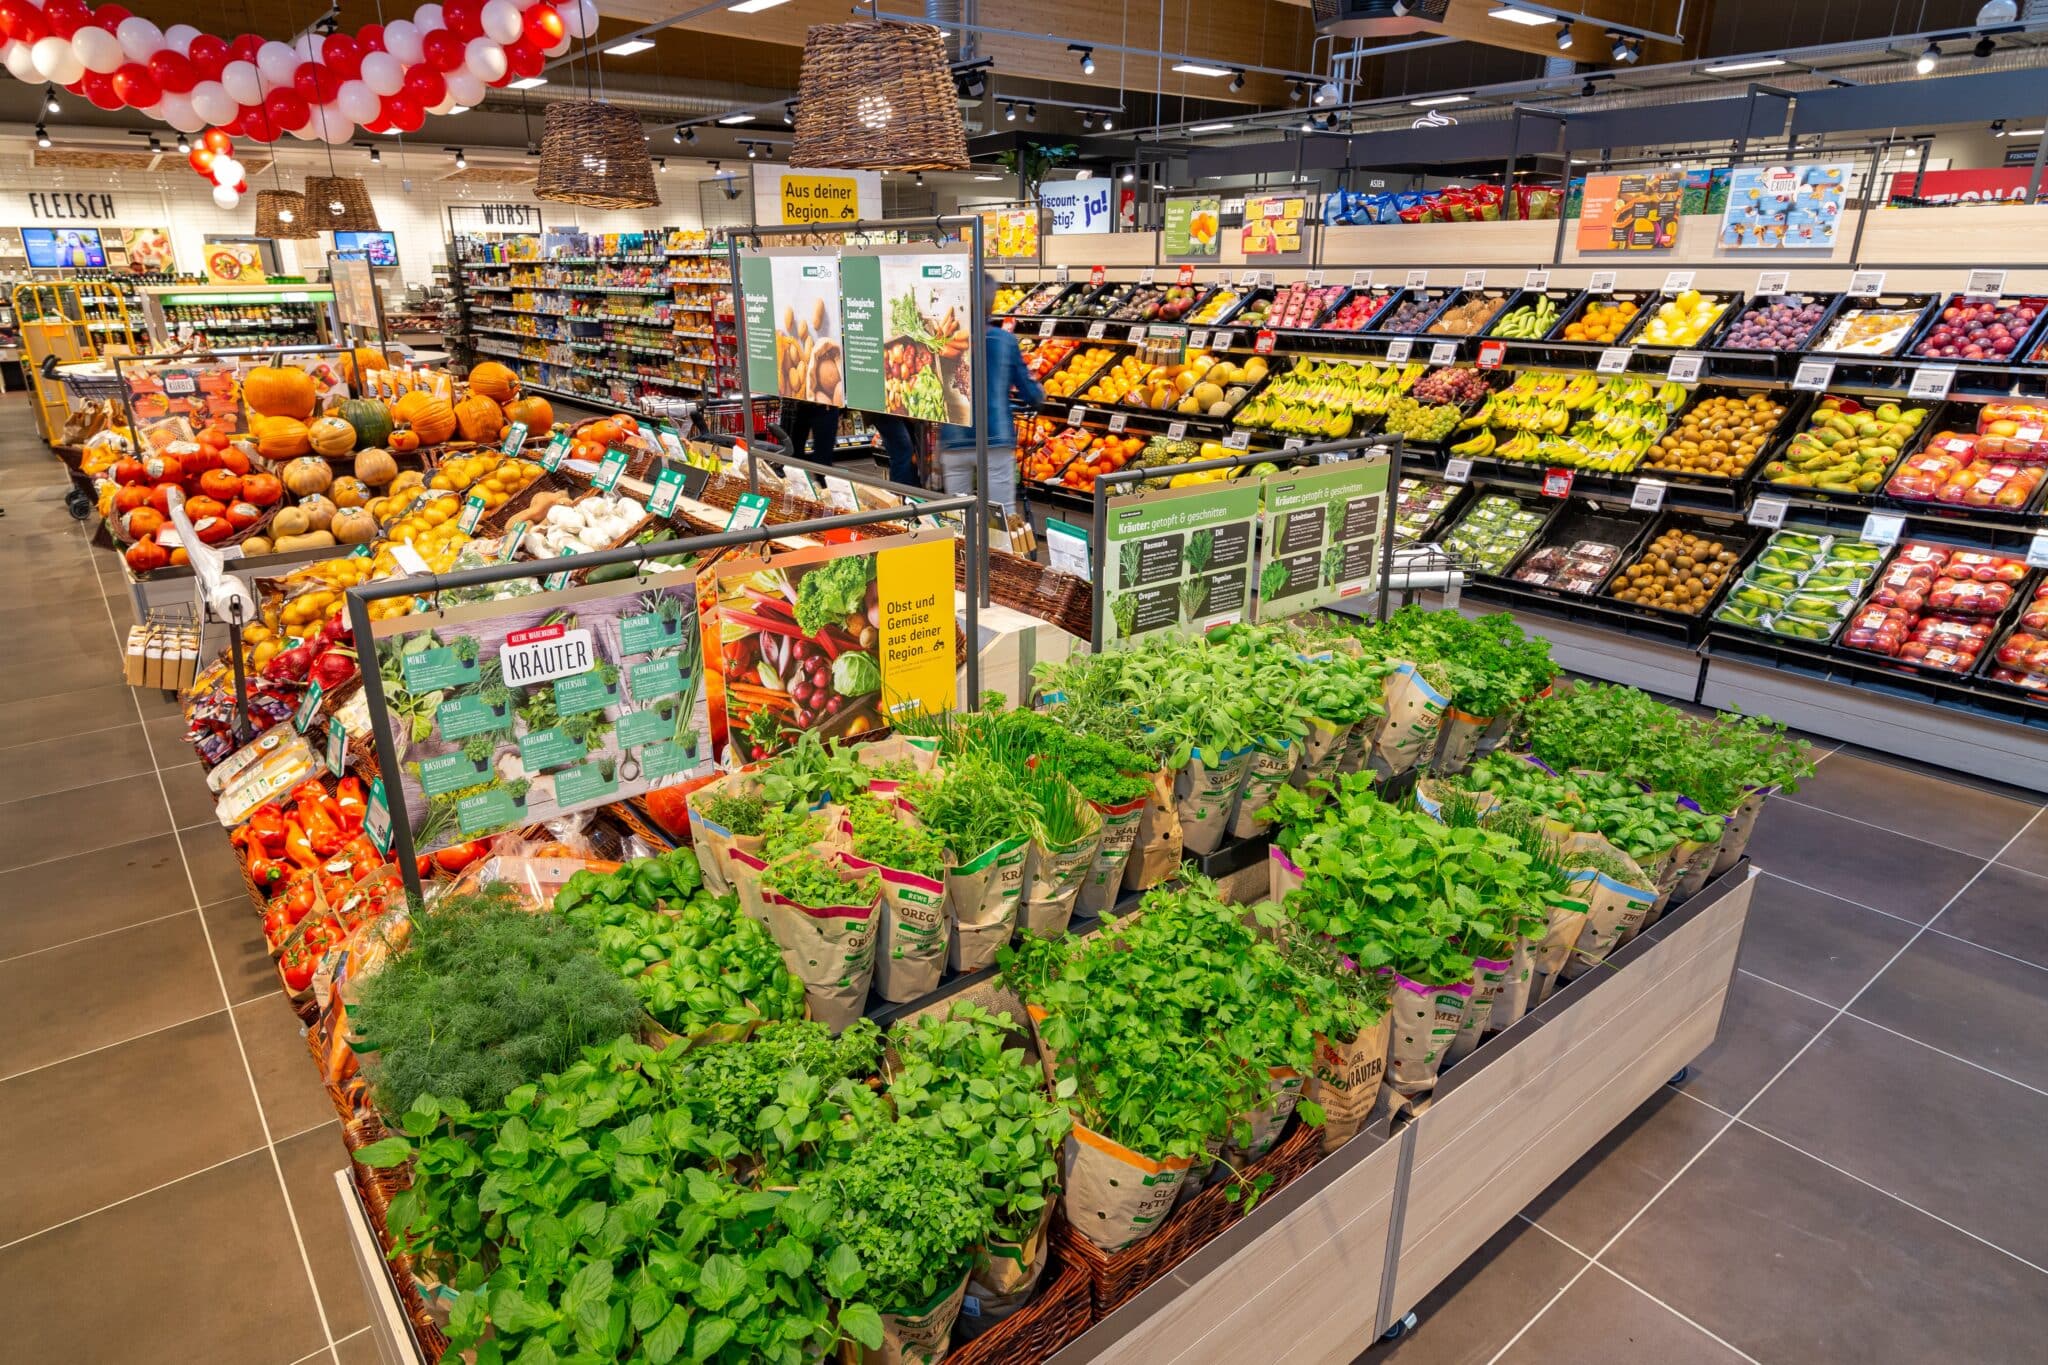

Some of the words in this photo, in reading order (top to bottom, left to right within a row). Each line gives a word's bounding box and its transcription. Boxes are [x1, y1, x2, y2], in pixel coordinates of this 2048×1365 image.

[785, 182, 810, 198] Aus
[814, 184, 852, 199] deiner
[1369, 178, 1386, 188] ASIEN
[1770, 179, 1798, 192] EXOTEN
[28, 192, 116, 219] FLEISCH
[481, 203, 532, 225] WURST
[786, 202, 829, 222] Region
[1083, 189, 1108, 228] ja!
[1052, 211, 1075, 229] stig?
[847, 309, 872, 321] Landwirt-
[848, 321, 864, 332] schaft
[1118, 521, 1150, 535] Kräuter:
[1151, 515, 1177, 531] getopft
[1179, 513, 1186, 523] &
[1187, 507, 1227, 525] geschnitten
[887, 600, 912, 614] Obst
[915, 594, 935, 609] und
[623, 617, 650, 629] ROSMARIN
[887, 613, 929, 631] Gemüse
[888, 634, 906, 646] aus
[910, 627, 942, 642] deiner
[407, 654, 426, 666] MINZE
[508, 641, 588, 681] KRÄUTER
[888, 645, 923, 662] Region
[558, 678, 588, 691] PETERSILIE
[440, 701, 462, 713] SALBEI
[523, 732, 554, 746] KORIANDER
[424, 757, 456, 772] BASILIKUM
[461, 796, 488, 810] OREGANO
[908, 892, 928, 904] REWE
[1316, 1065, 1347, 1091] Bio
[1345, 1058, 1382, 1092] KRÄUTER
